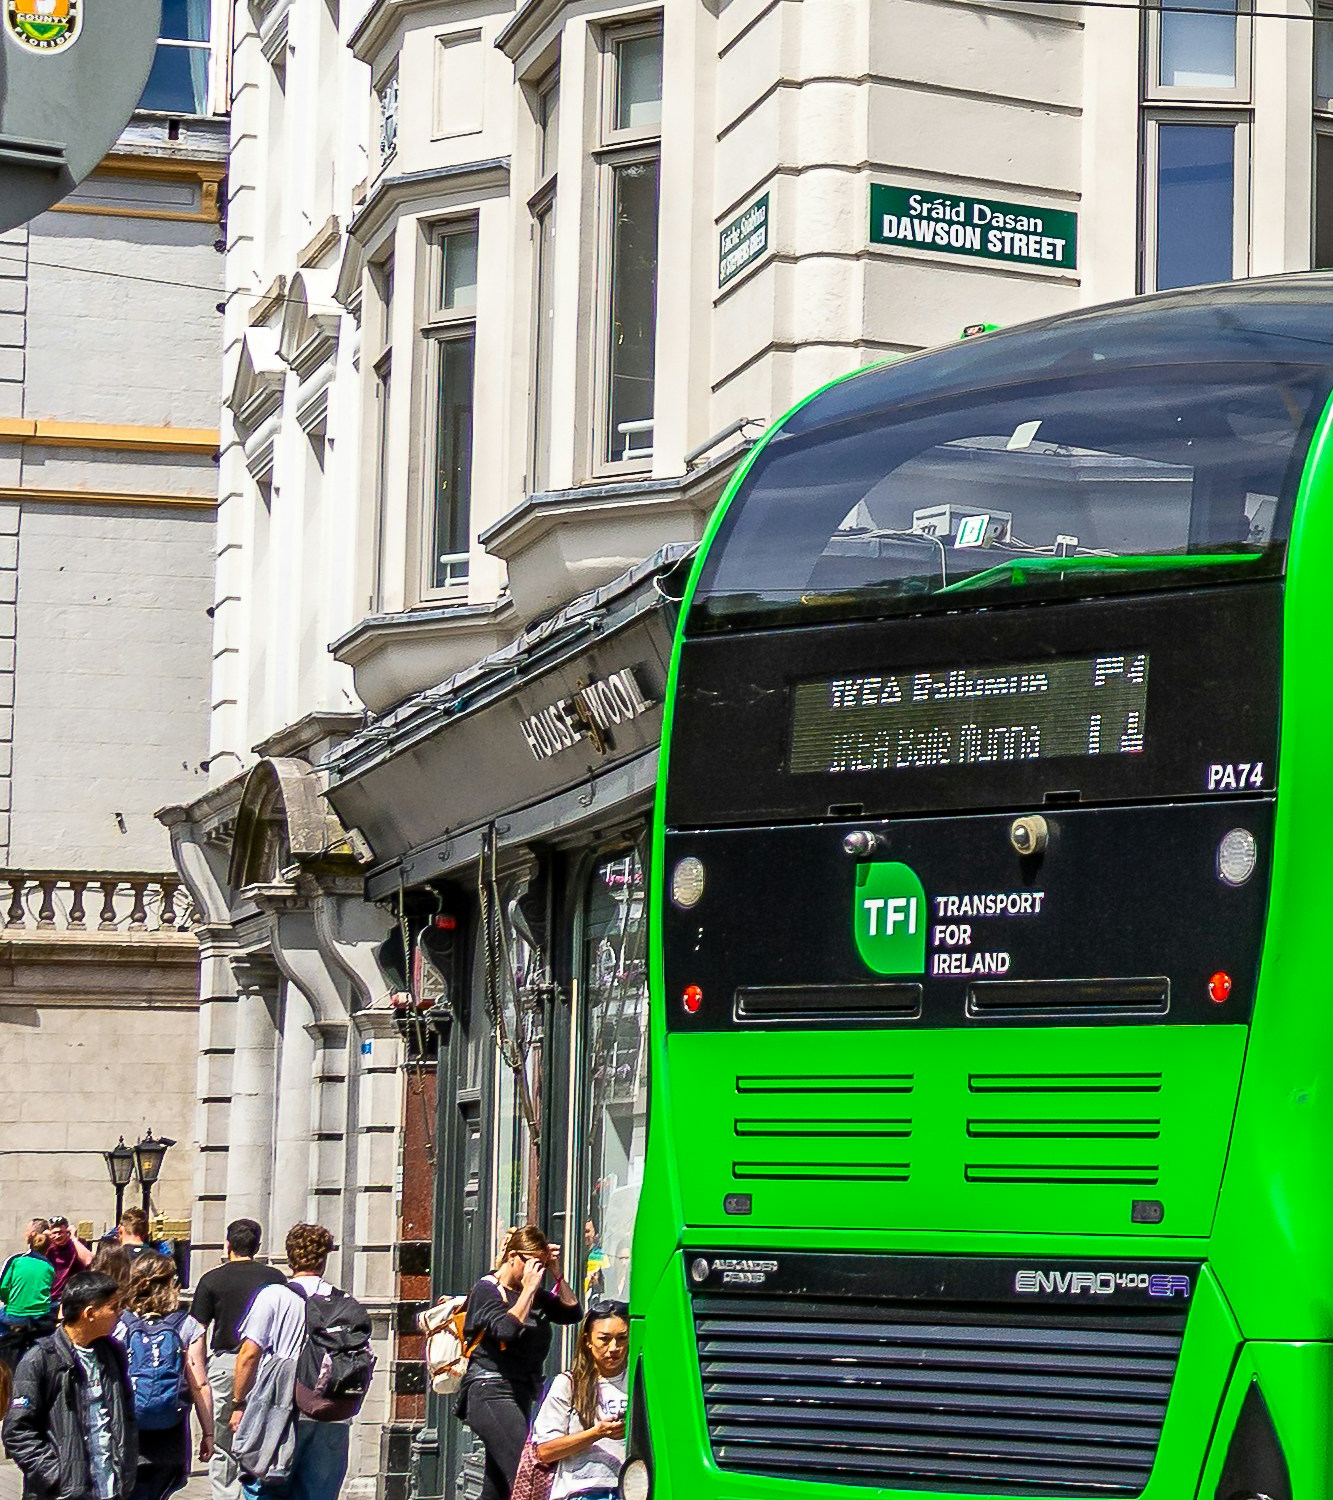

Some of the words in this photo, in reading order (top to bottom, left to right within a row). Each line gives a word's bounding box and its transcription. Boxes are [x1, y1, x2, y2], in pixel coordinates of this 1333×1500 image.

[17, 12, 70, 24] COUNTY
[14, 26, 72, 49] FLORIDA
[908, 194, 965, 223] Sráid
[973, 203, 1044, 233] Dasan
[882, 213, 984, 250] DAWSON
[987, 229, 1066, 262] STREET
[519, 699, 582, 761] HOUSE
[581, 667, 654, 731] WOOL
[1208, 762, 1264, 790] PA74
[863, 896, 917, 937] TFI
[934, 891, 1045, 917] TRANSPORT
[933, 924, 972, 946] FOR
[932, 951, 1011, 976] IRELAND
[711, 1259, 779, 1272] ALEXANDER
